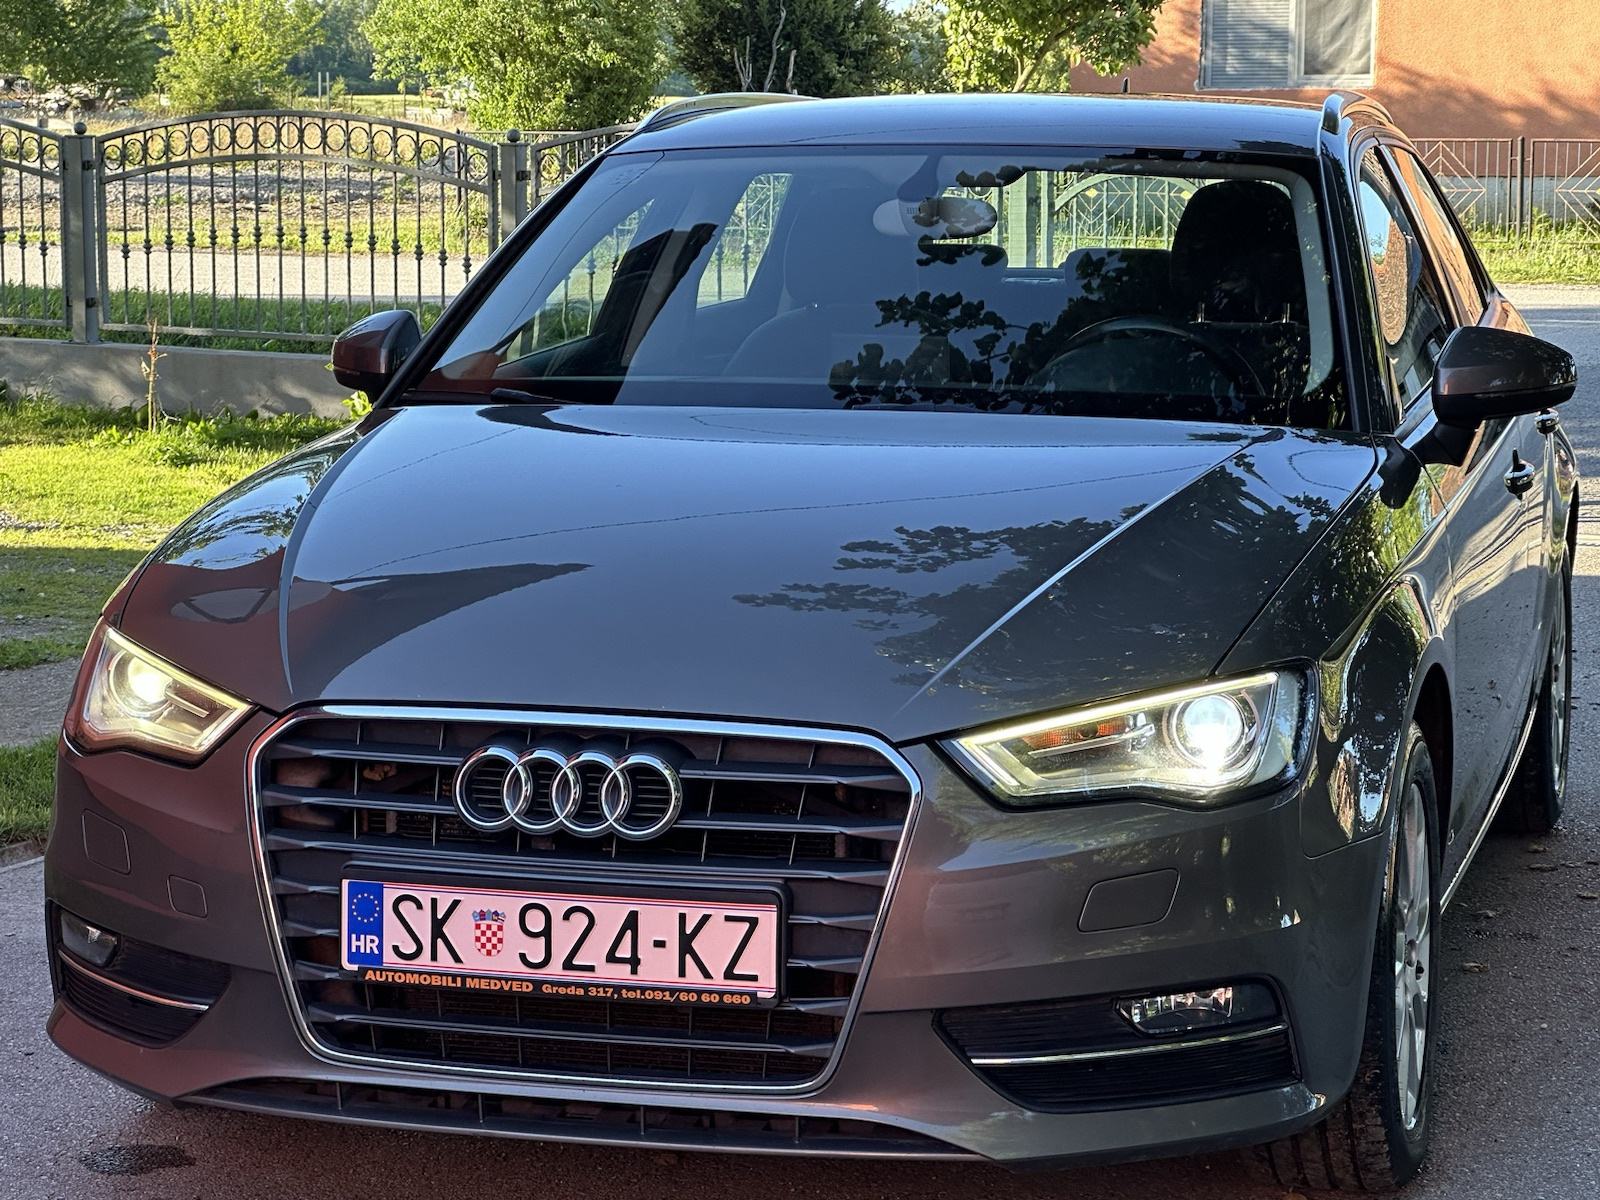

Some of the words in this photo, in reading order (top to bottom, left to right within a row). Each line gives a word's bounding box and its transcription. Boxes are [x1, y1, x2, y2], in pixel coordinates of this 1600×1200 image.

[351, 934, 380, 954] HR
[391, 893, 464, 964] SK
[518, 902, 760, 982] 924-KZ
[364, 969, 462, 988] AUTOMOBILI
[465, 976, 534, 993] MEDVED
[541, 984, 585, 997] Greda
[587, 986, 618, 999] 317,
[620, 989, 698, 1003] tel.091/60
[700, 992, 720, 1003] 60
[722, 993, 752, 1005] 660
